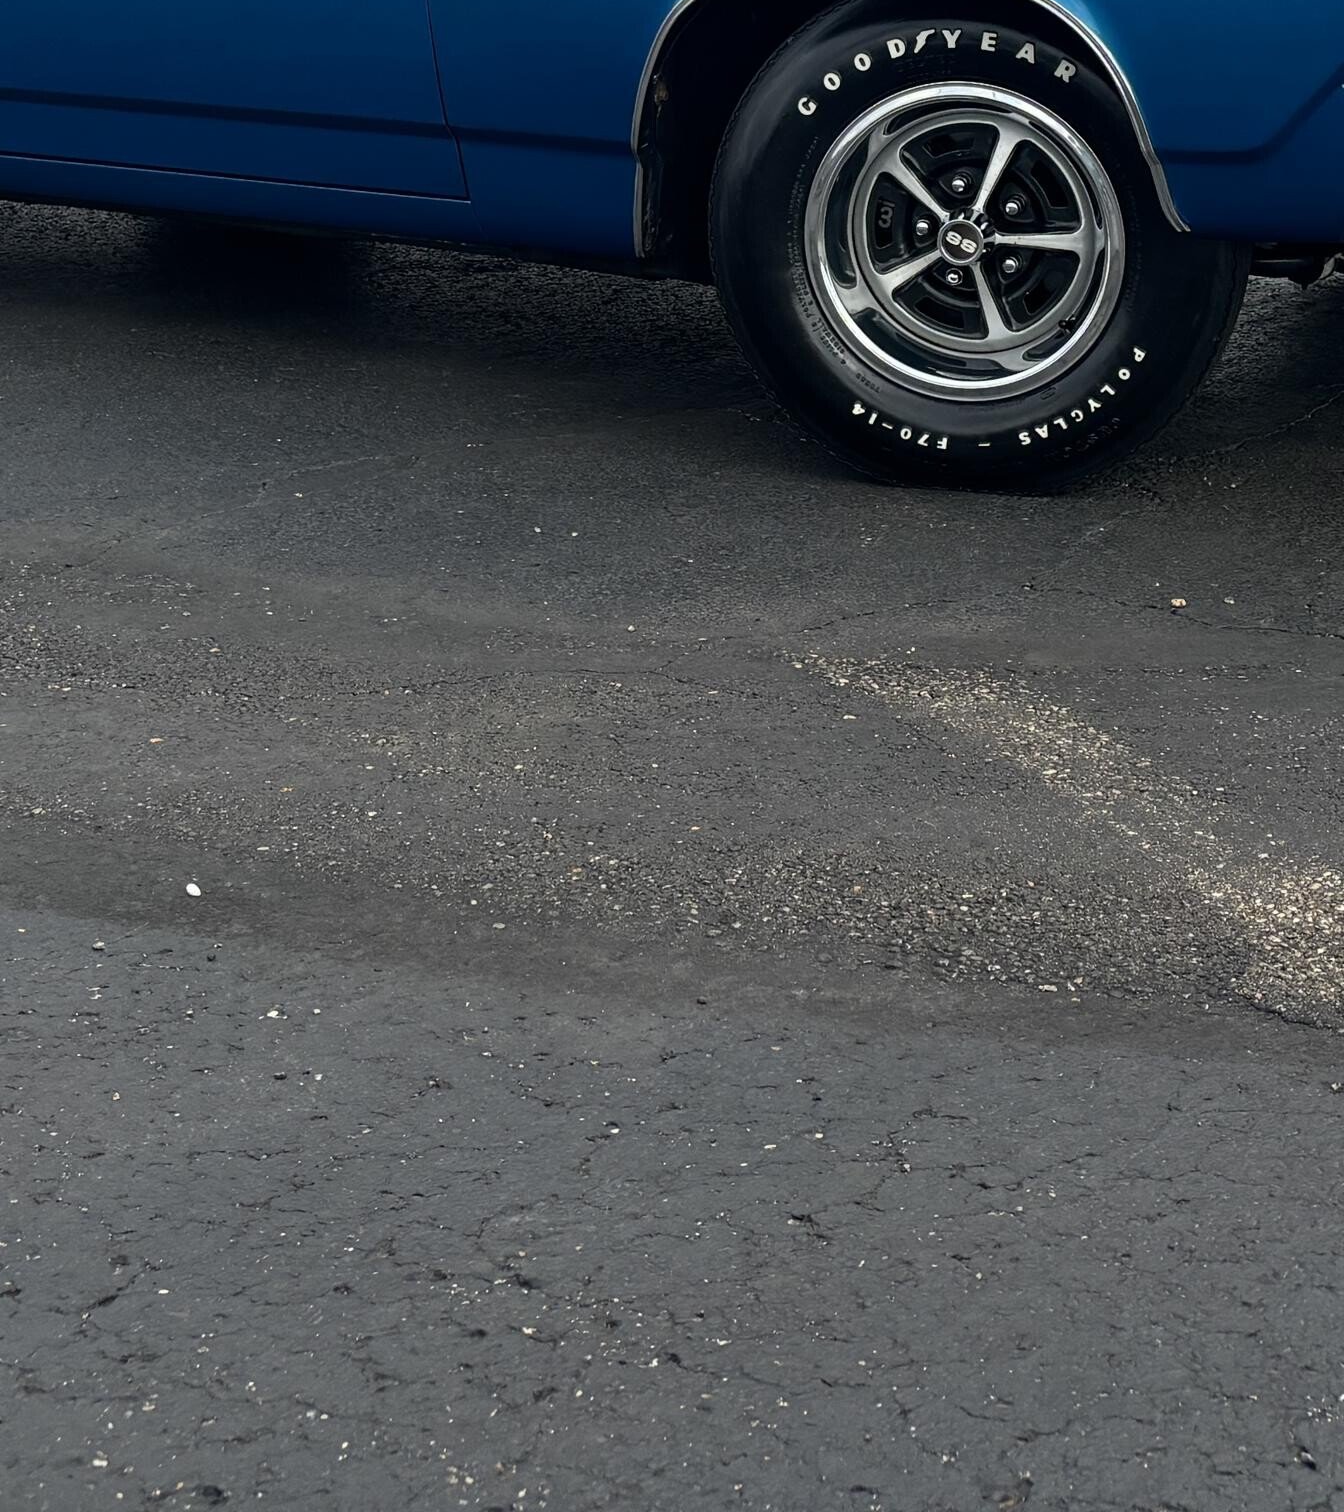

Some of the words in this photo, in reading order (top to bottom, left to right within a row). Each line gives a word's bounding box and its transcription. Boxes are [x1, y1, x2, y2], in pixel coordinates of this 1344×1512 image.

[797, 29, 1077, 116] GOODYEAR
[945, 231, 977, 254] SS
[852, 402, 948, 450] F70-14
[1018, 346, 1146, 446] POLYGLAS
